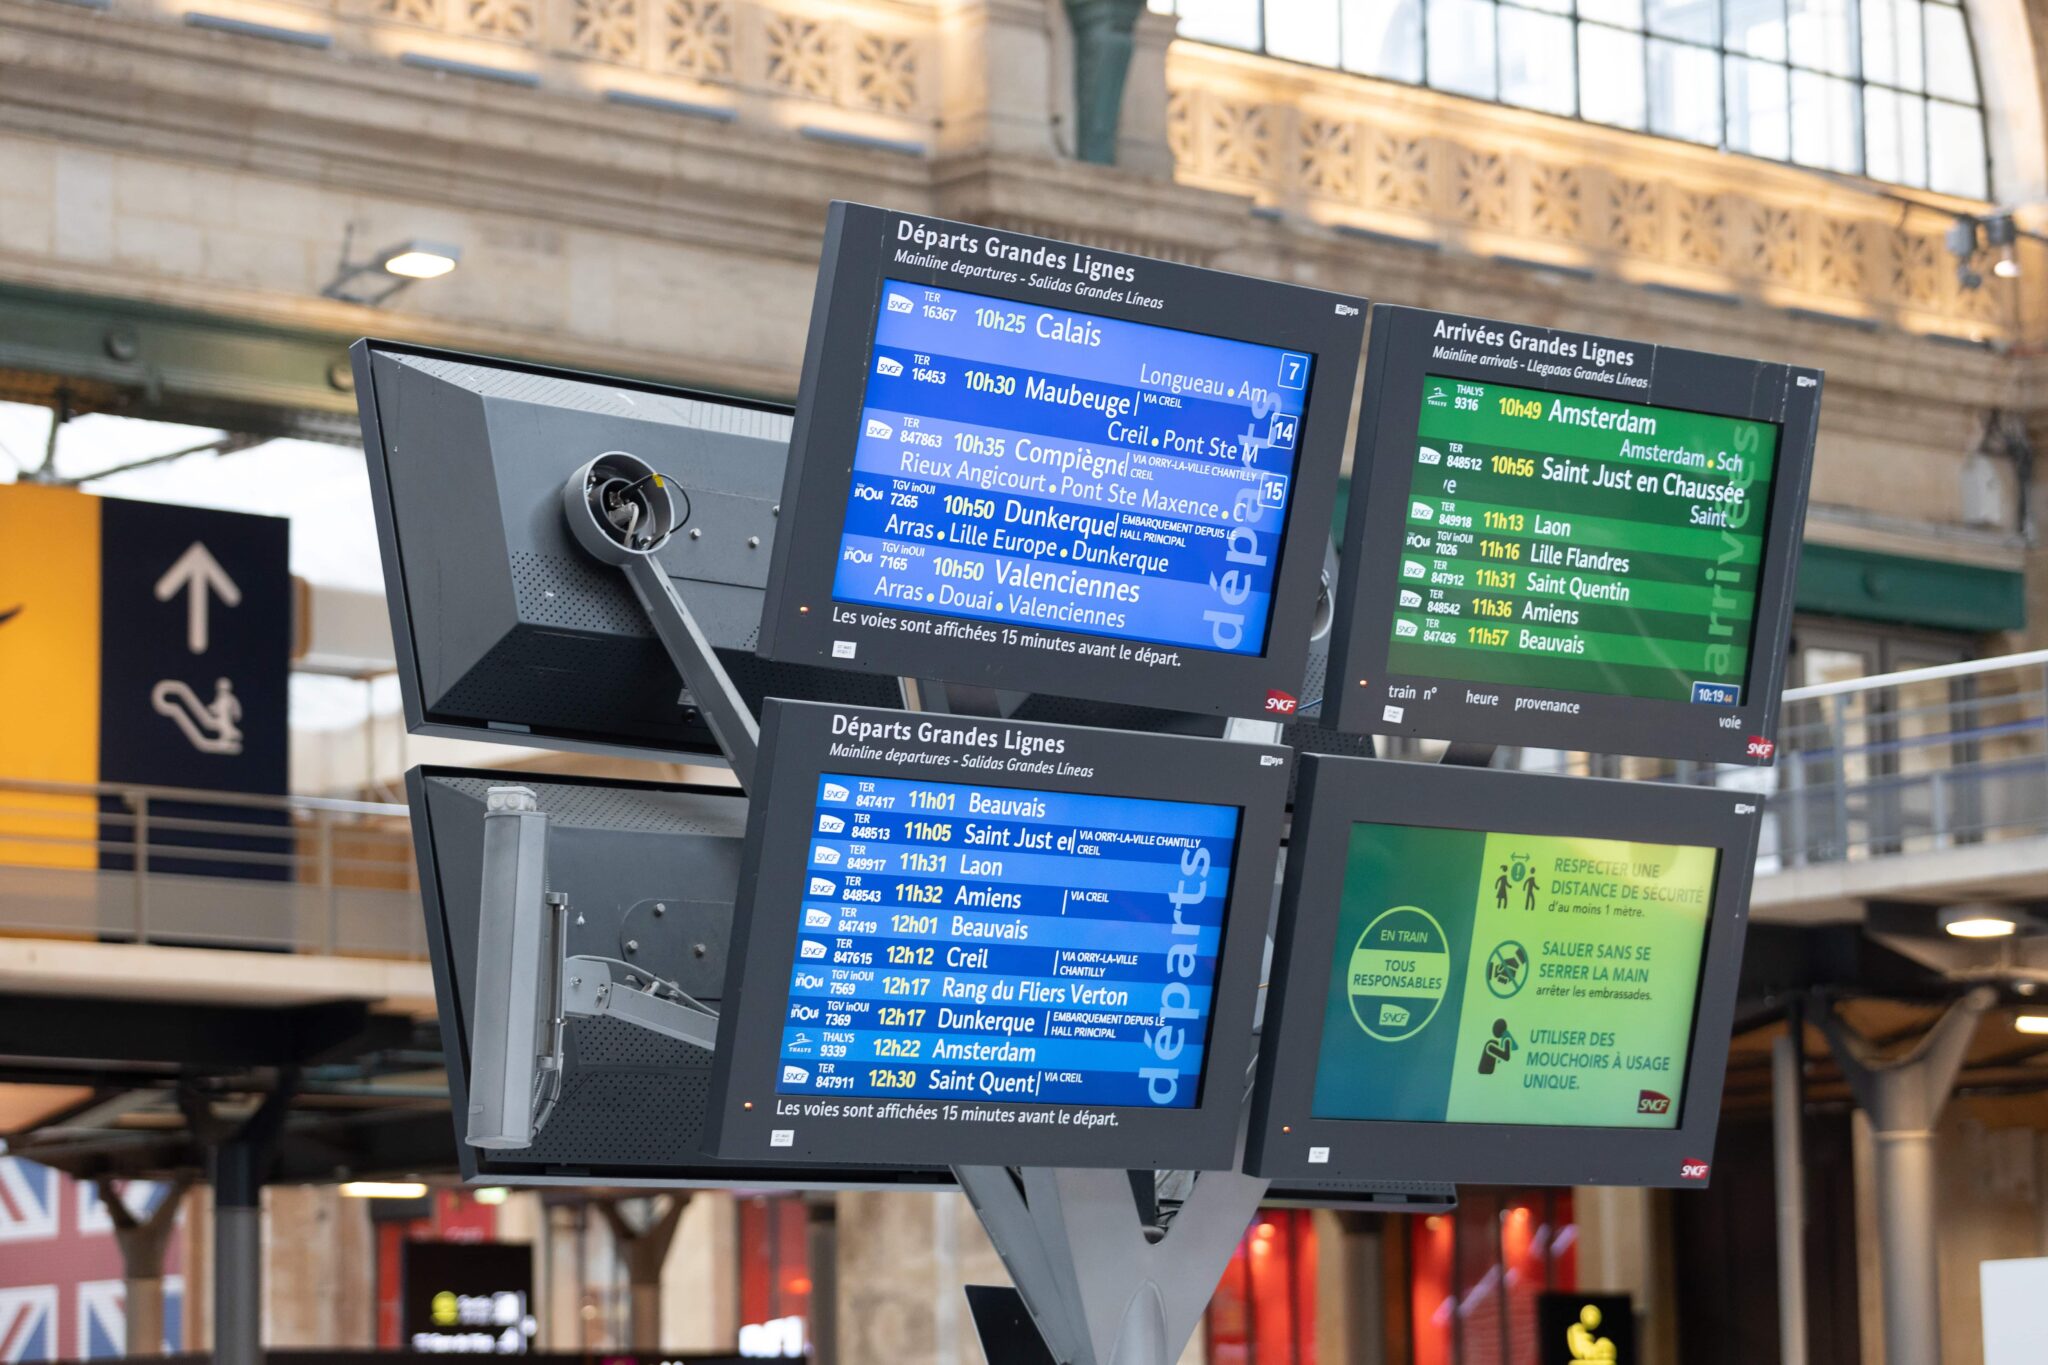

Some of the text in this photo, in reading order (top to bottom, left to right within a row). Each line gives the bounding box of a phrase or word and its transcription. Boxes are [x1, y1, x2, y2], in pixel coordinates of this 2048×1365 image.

[897, 220, 1135, 282] Départs Grandes Lignes
[894, 248, 1164, 309] Mainline departures Salidas Grandes Líneas
[925, 291, 941, 303] TER
[923, 305, 957, 322] 16367
[975, 308, 1101, 347] 10h25 Calais
[1433, 319, 1634, 367] Arrivées Grandes Lignes
[1140, 363, 1224, 396] Longueau
[1289, 362, 1300, 380] 7
[964, 370, 1130, 419] 10h30 Maubeuge
[1143, 393, 1182, 408] VIA CREIL
[1457, 384, 1484, 397] THALYS
[1454, 396, 1479, 411] 9316
[1499, 397, 1656, 435] 10h49 Amsterdam
[1108, 420, 1238, 460] Creil Pont Ste
[1274, 421, 1294, 442] 14
[954, 432, 1005, 458] 10h35
[1619, 439, 1706, 468] Amsterdam
[893, 479, 936, 495] TGV inOUI
[900, 450, 1219, 518] Rieux Angicourt Pont Ste Maxence
[1264, 481, 1284, 502] 15
[1491, 455, 1744, 504] 10h56 Saint Just en Chaussée
[891, 492, 918, 509] 7265
[944, 495, 1115, 539] 10h50 Dunkerque
[1484, 511, 1571, 537] 11h13 Laon
[1690, 505, 1727, 527] Saint
[884, 513, 1169, 575] Arras Lille Europe Dunkerque
[1120, 529, 1186, 547] HALL PRINCIPAL
[1704, 426, 1759, 675] arrivées
[1480, 540, 1629, 573] 11h16 Lille Flandres
[933, 557, 1140, 603] 10h50 Valenciennes
[1476, 569, 1630, 601] 11h31 Saint Quentin
[874, 576, 1125, 628] Arras Douai Valenciennes
[1472, 598, 1579, 625] 11h36 Amiens
[833, 606, 1181, 667] Les voies sont affichées 15 minutes avant le départ.
[1468, 627, 1584, 654] 11h57 Beauvais
[1265, 697, 1295, 713] SNCF
[1388, 685, 1416, 699] train
[1466, 690, 1499, 706] heure
[1514, 698, 1580, 714] provenance
[1719, 715, 1742, 729] voie
[1698, 688, 1724, 703] 10:19
[832, 714, 1065, 756] Départs Grandes Lignes
[856, 794, 895, 809] 847417
[909, 790, 1045, 818] 11h01 Beauvais
[905, 821, 1053, 850] 11h05 Saint Just
[900, 852, 1003, 876] 11h31 Laon
[1554, 857, 1661, 878] RESPECTER UNE
[896, 884, 1022, 909] 11h32 Amiens
[1551, 880, 1704, 903] DISTANCE DE SÉCURITÉ
[1548, 900, 1645, 917] d'au moins 1 mètre.
[891, 915, 1028, 940] 12h01 Beauvais
[1380, 929, 1428, 943] EN TRAIN
[887, 946, 988, 969] 12h12 Creil
[1542, 941, 1651, 961] SALUER SANS SE
[1138, 847, 1212, 1104] départs
[1385, 959, 1416, 973] TOUS
[1539, 963, 1649, 983] SERRER LA MAIN
[830, 982, 856, 995] 7569
[882, 976, 1128, 1006] 12h17 Rang du Fliers Verton
[1353, 974, 1442, 990] RESPONSABLES
[1536, 984, 1652, 1000] arrêter les embrassades.
[878, 1007, 1035, 1036] 12h17 Dunkerque
[873, 1038, 1036, 1062] 12h22 Amsterdam
[1530, 1029, 1615, 1047] UTILISER DES
[1526, 1051, 1670, 1071] MOUCHOIRS À USAGE
[869, 1069, 1035, 1095] 12h30 Saint Quent
[1523, 1074, 1579, 1090] UNIQUE.
[1639, 1098, 1670, 1113] SNCF
